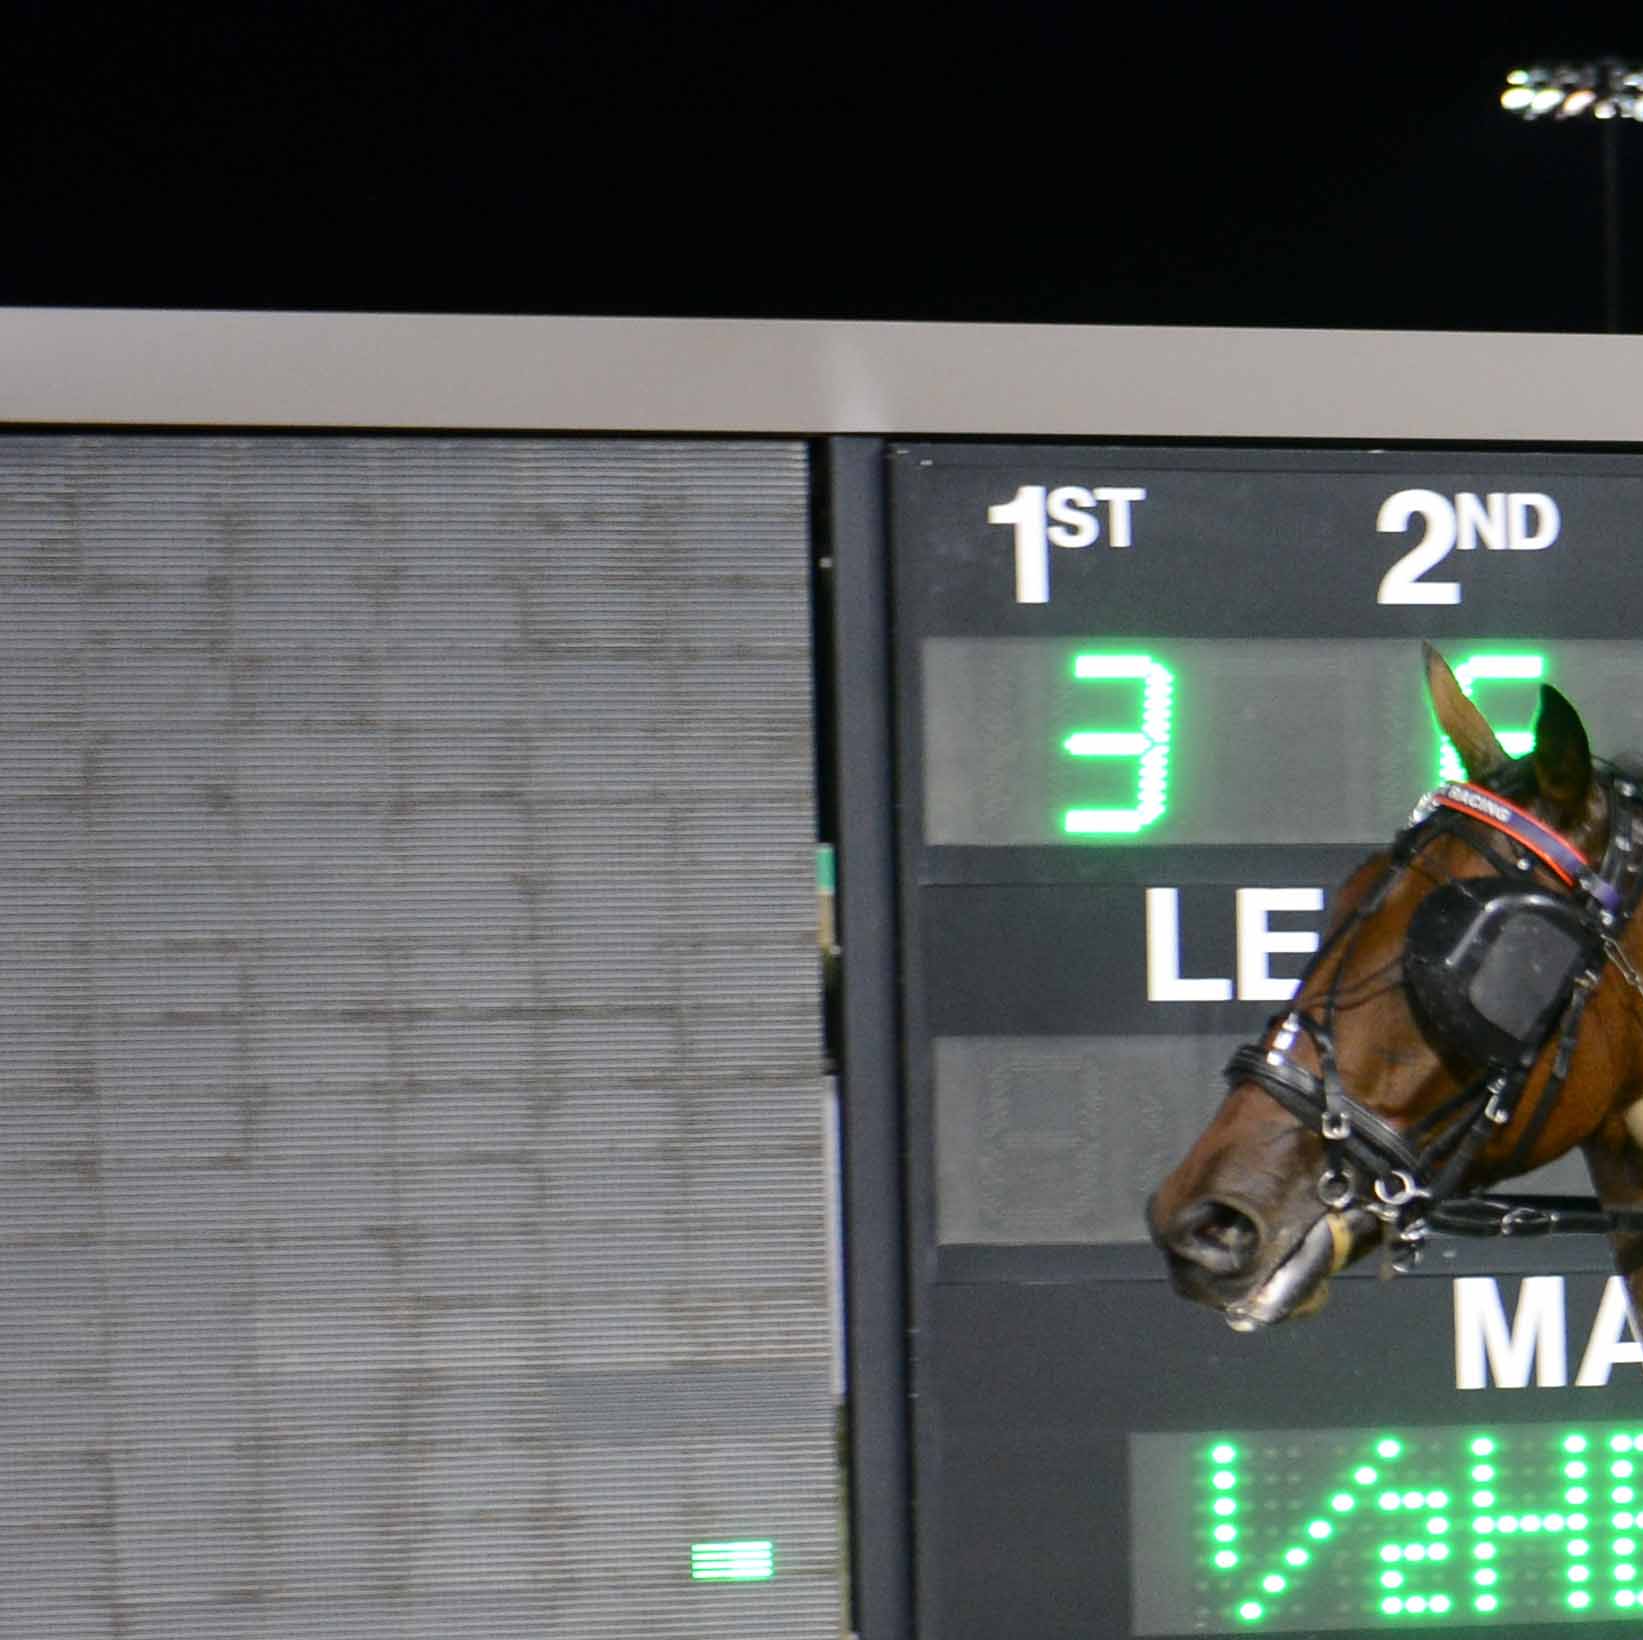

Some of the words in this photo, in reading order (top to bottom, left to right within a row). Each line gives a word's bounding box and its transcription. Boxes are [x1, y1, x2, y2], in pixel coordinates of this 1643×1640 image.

[988, 485, 1146, 604] 1ST
[1377, 488, 1560, 605] 2ND
[1060, 652, 1176, 836] 3
